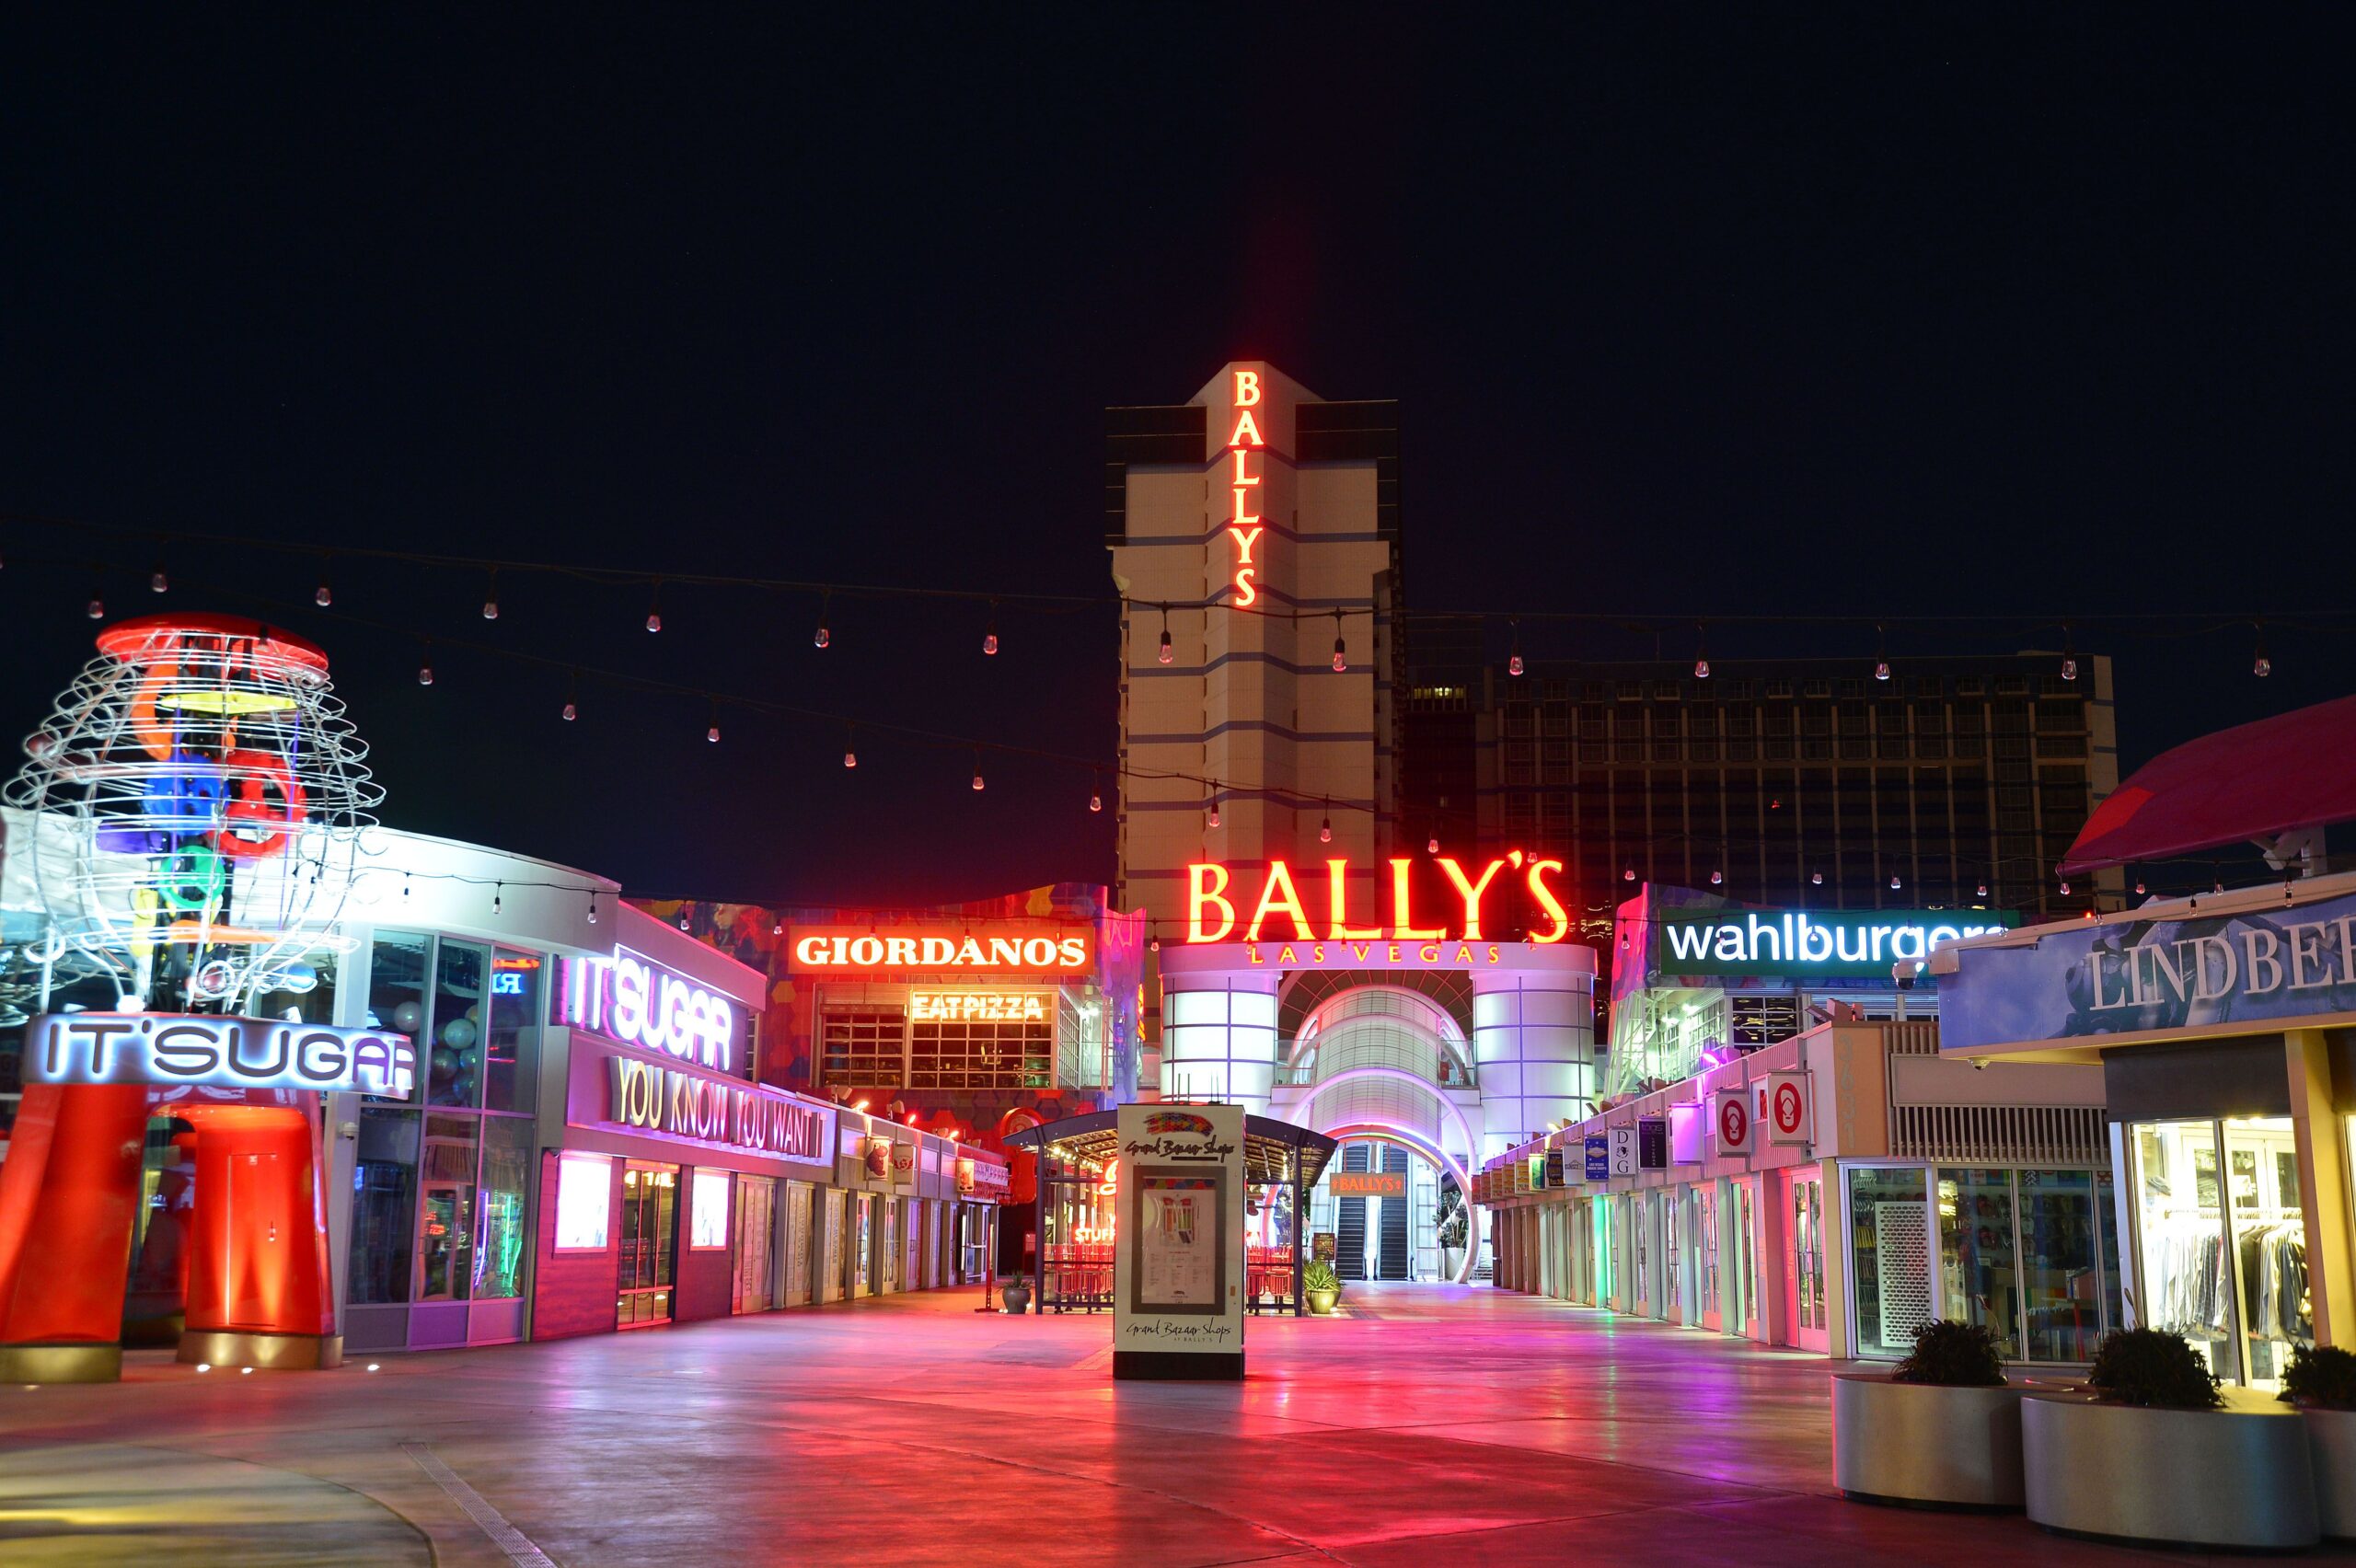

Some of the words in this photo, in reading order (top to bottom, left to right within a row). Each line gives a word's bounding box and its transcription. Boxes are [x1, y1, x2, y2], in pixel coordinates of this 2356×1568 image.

[1230, 371, 1265, 606] BALLYS
[1185, 849, 1567, 944] BALLY'S
[1251, 946, 1325, 964] LAS
[1354, 945, 1500, 963] VEGAS
[1667, 914, 2009, 972] wahlburge
[572, 945, 732, 1071] IT'SUGAR
[47, 1020, 416, 1083] IT'SUGAR
[614, 1056, 663, 1129] YOU
[669, 1070, 729, 1141] KNOW
[735, 1090, 768, 1148] YOU
[773, 1101, 812, 1157] WANT
[815, 1112, 827, 1159] IT
[1339, 1176, 1393, 1191] BALLY'S
[1126, 1319, 1161, 1337] Grand
[1160, 1322, 1201, 1338] Bazaar
[1202, 1317, 1231, 1343] Shops
